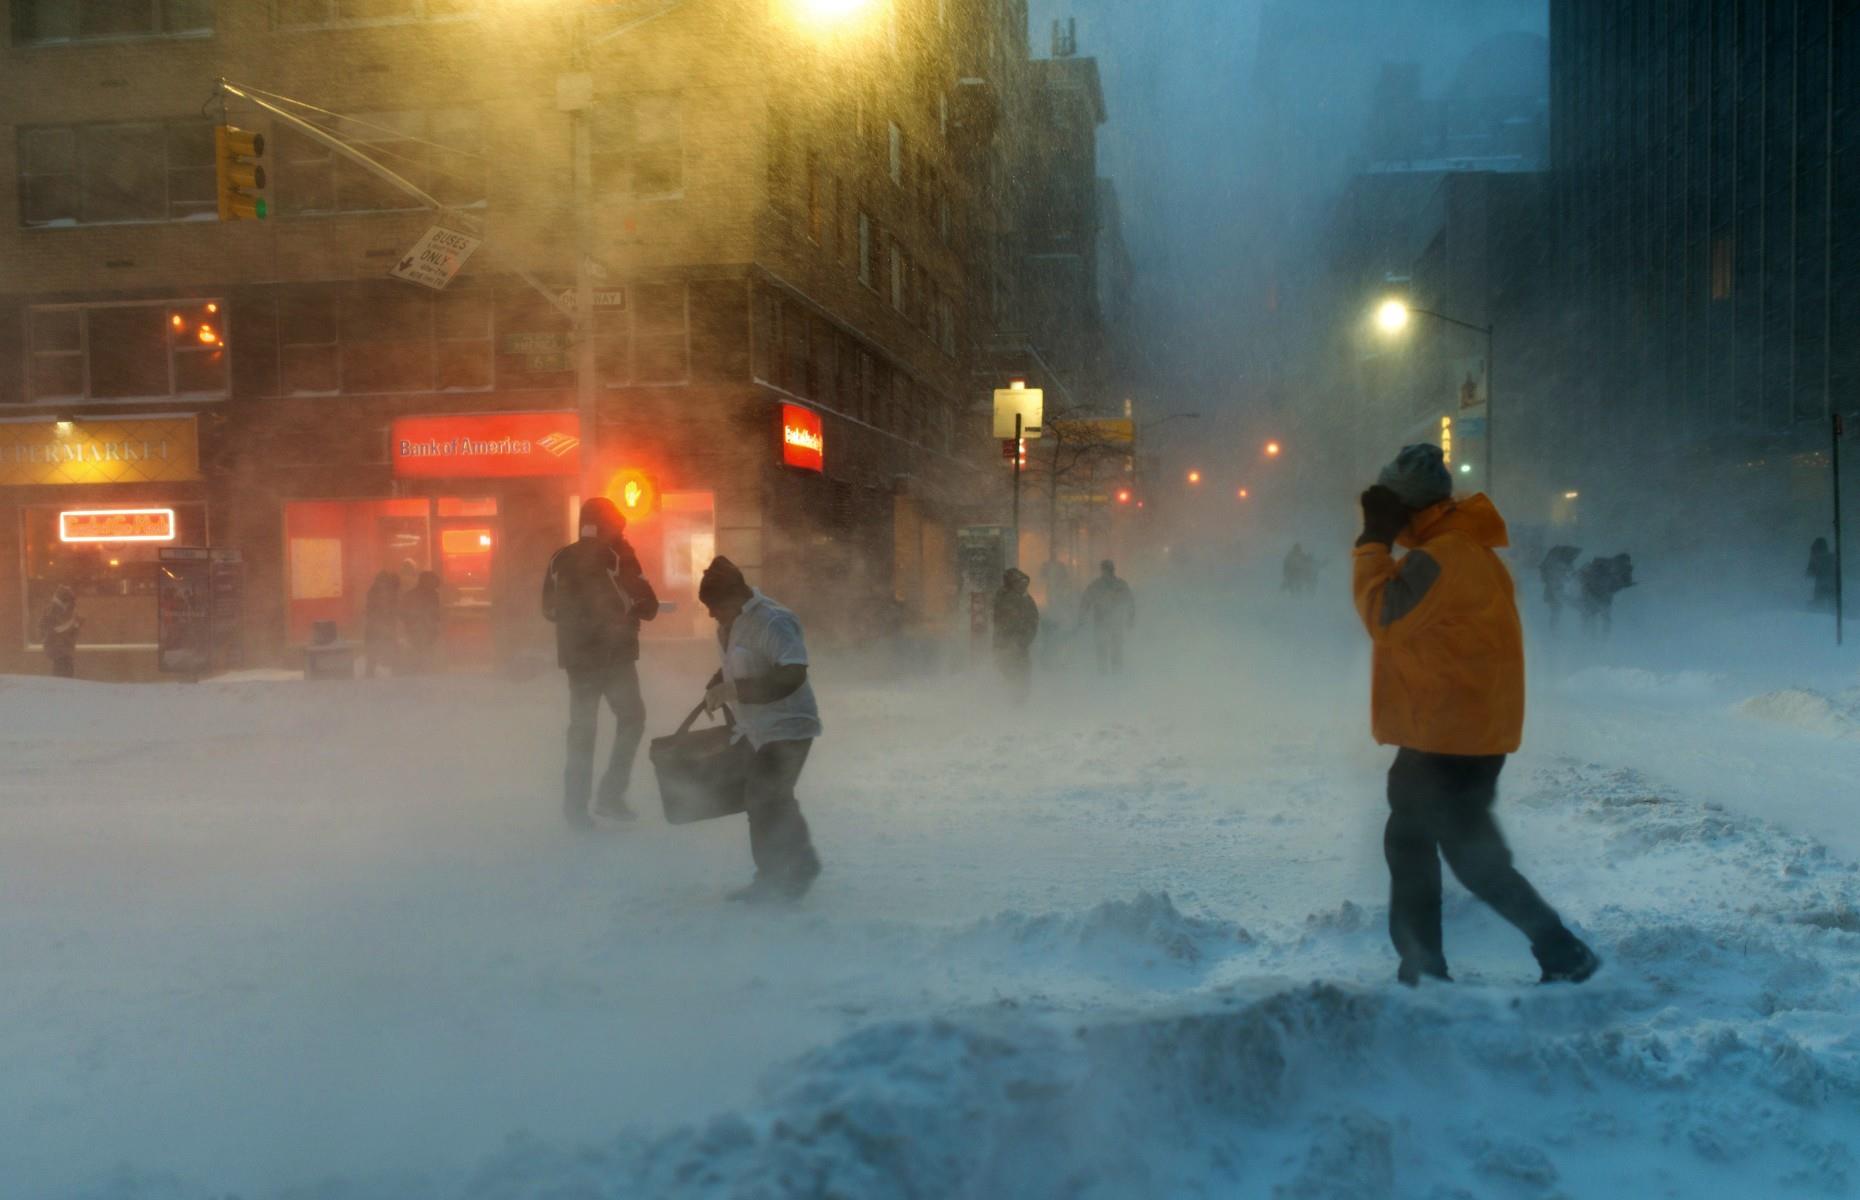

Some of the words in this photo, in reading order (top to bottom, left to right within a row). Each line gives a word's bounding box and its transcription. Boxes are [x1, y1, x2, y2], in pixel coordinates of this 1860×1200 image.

[432, 230, 469, 250] BUSES
[420, 249, 451, 265] ONLY
[593, 292, 618, 305] WAY
[400, 439, 441, 457] Bank
[444, 438, 458, 457] of
[462, 436, 532, 456] America
[1441, 416, 1451, 464] PARK
